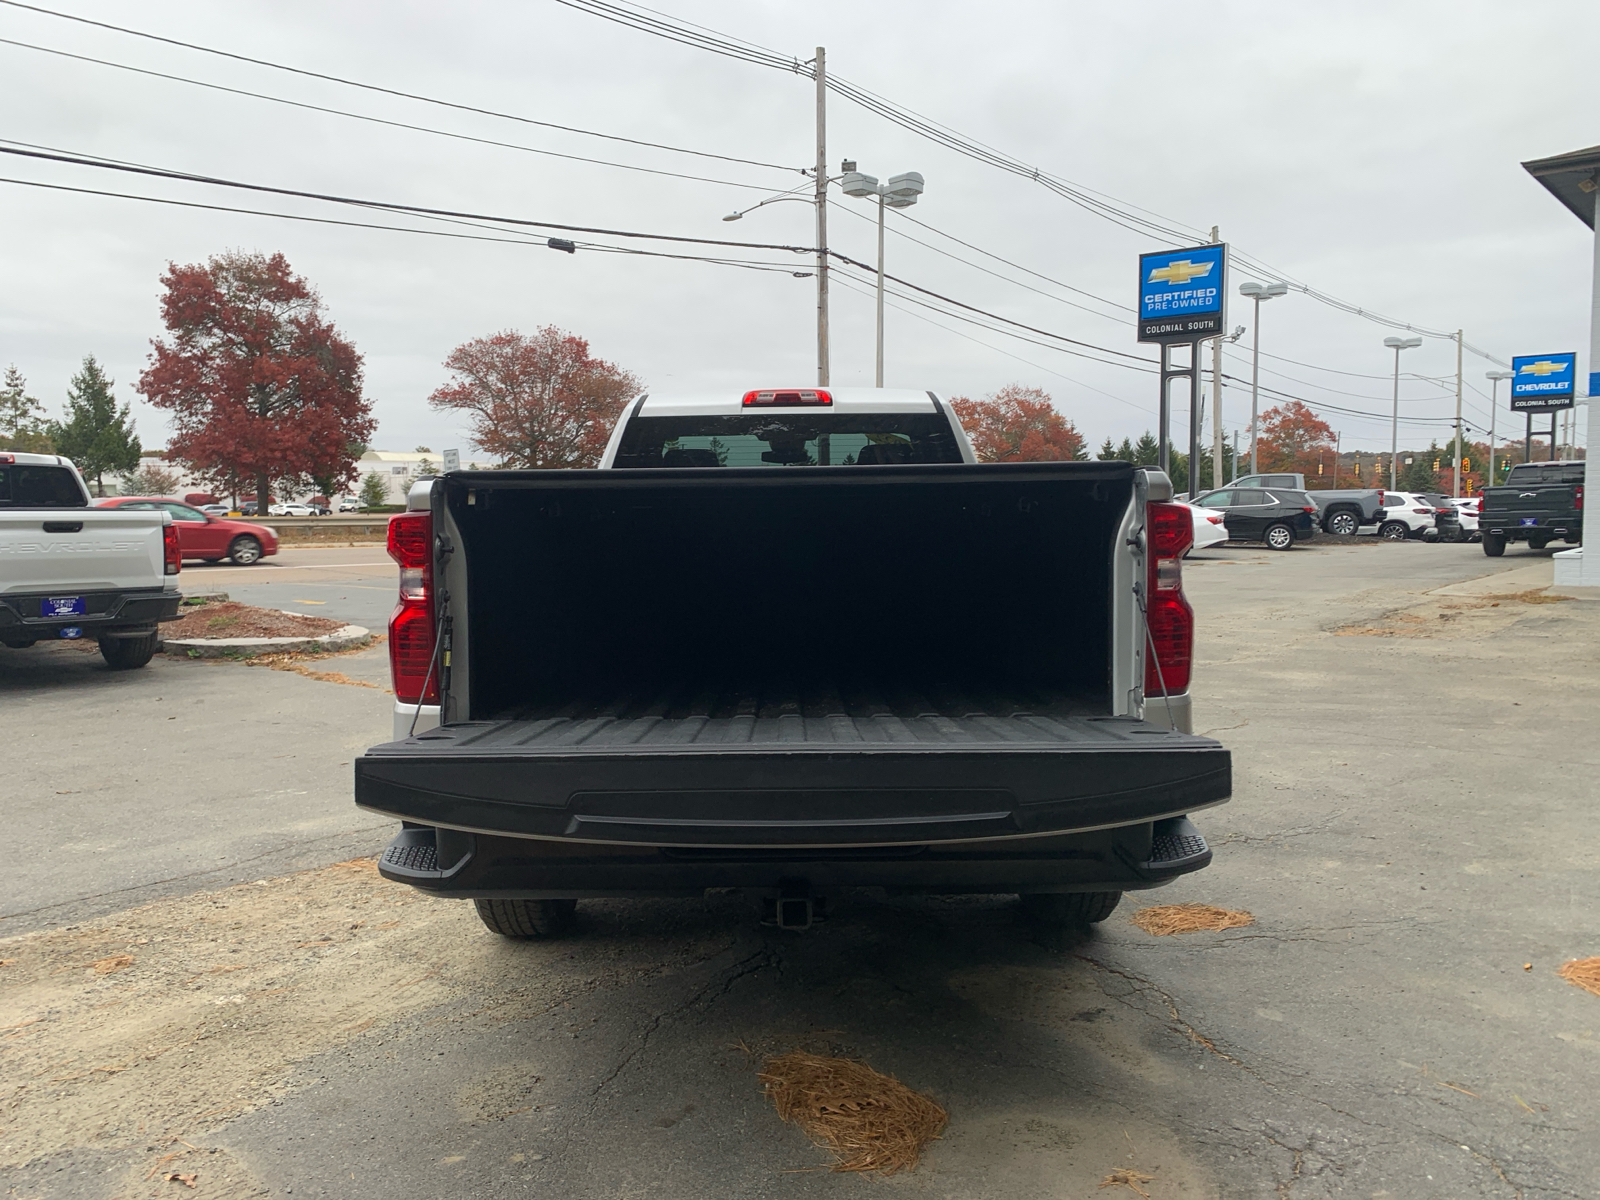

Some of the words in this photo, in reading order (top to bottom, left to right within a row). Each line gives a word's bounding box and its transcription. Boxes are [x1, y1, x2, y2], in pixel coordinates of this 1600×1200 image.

[1144, 287, 1217, 303] CERTIFIED
[1148, 297, 1213, 311] PRE-OWNED
[1146, 323, 1184, 334] COLONIAL
[1187, 320, 1214, 330] SOUTH
[1516, 381, 1570, 392] CHEVROLET
